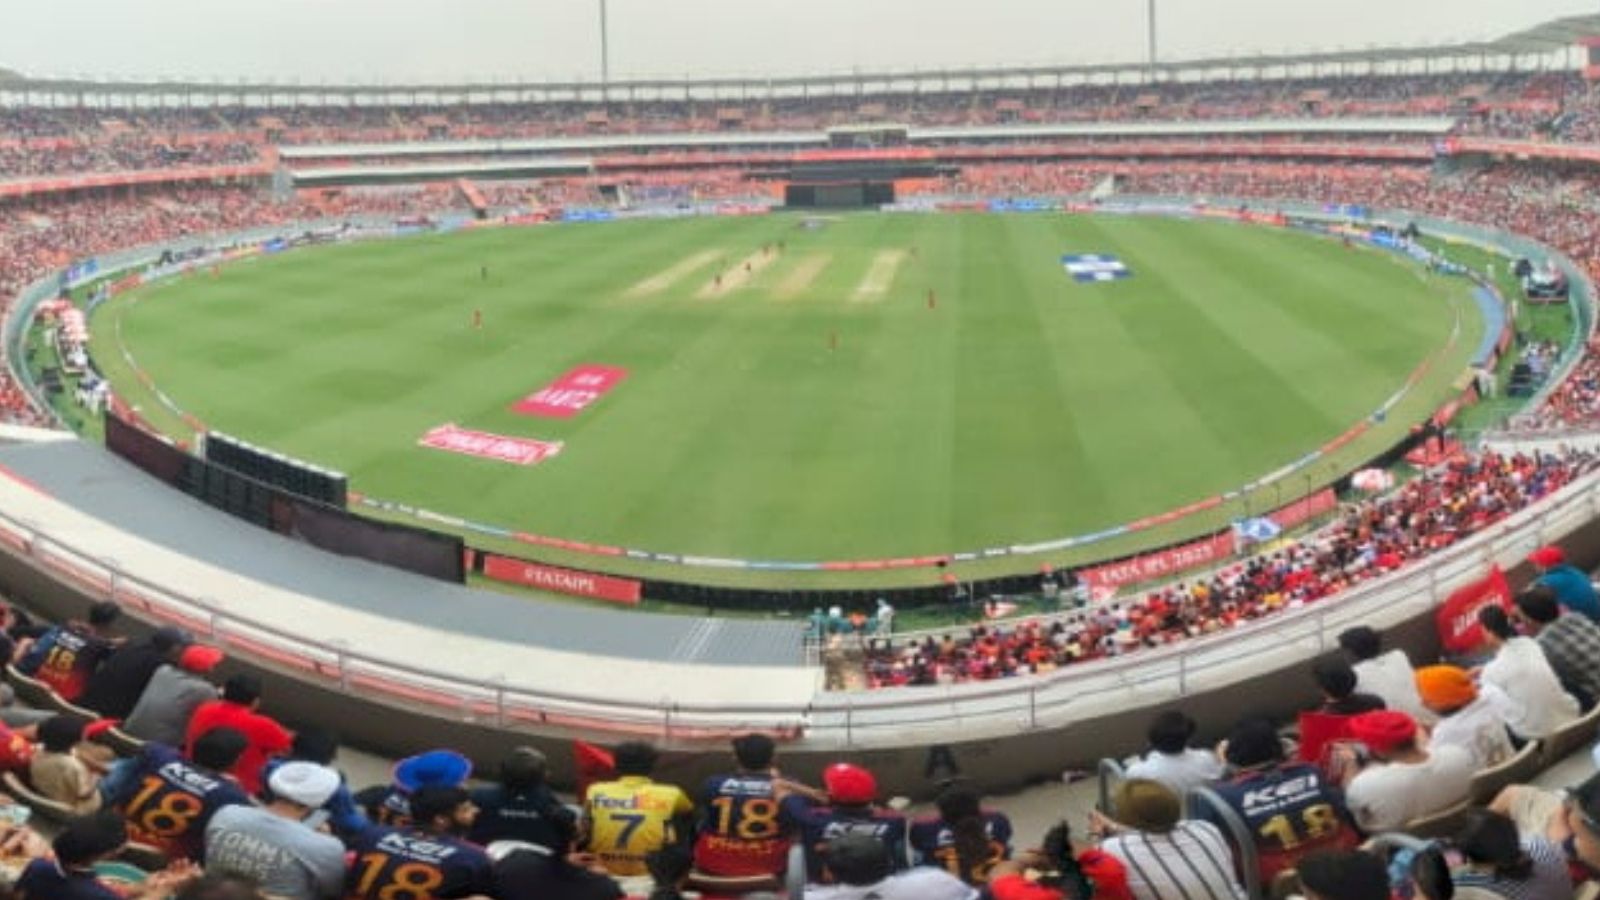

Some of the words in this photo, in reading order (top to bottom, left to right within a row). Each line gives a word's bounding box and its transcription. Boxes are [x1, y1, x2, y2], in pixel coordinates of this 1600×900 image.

[127, 774, 203, 837] 18
[1242, 773, 1318, 807] KEI
[609, 814, 645, 850] 7
[711, 796, 778, 839] 18
[209, 827, 295, 866] TOMMY
[358, 851, 445, 900] 18
